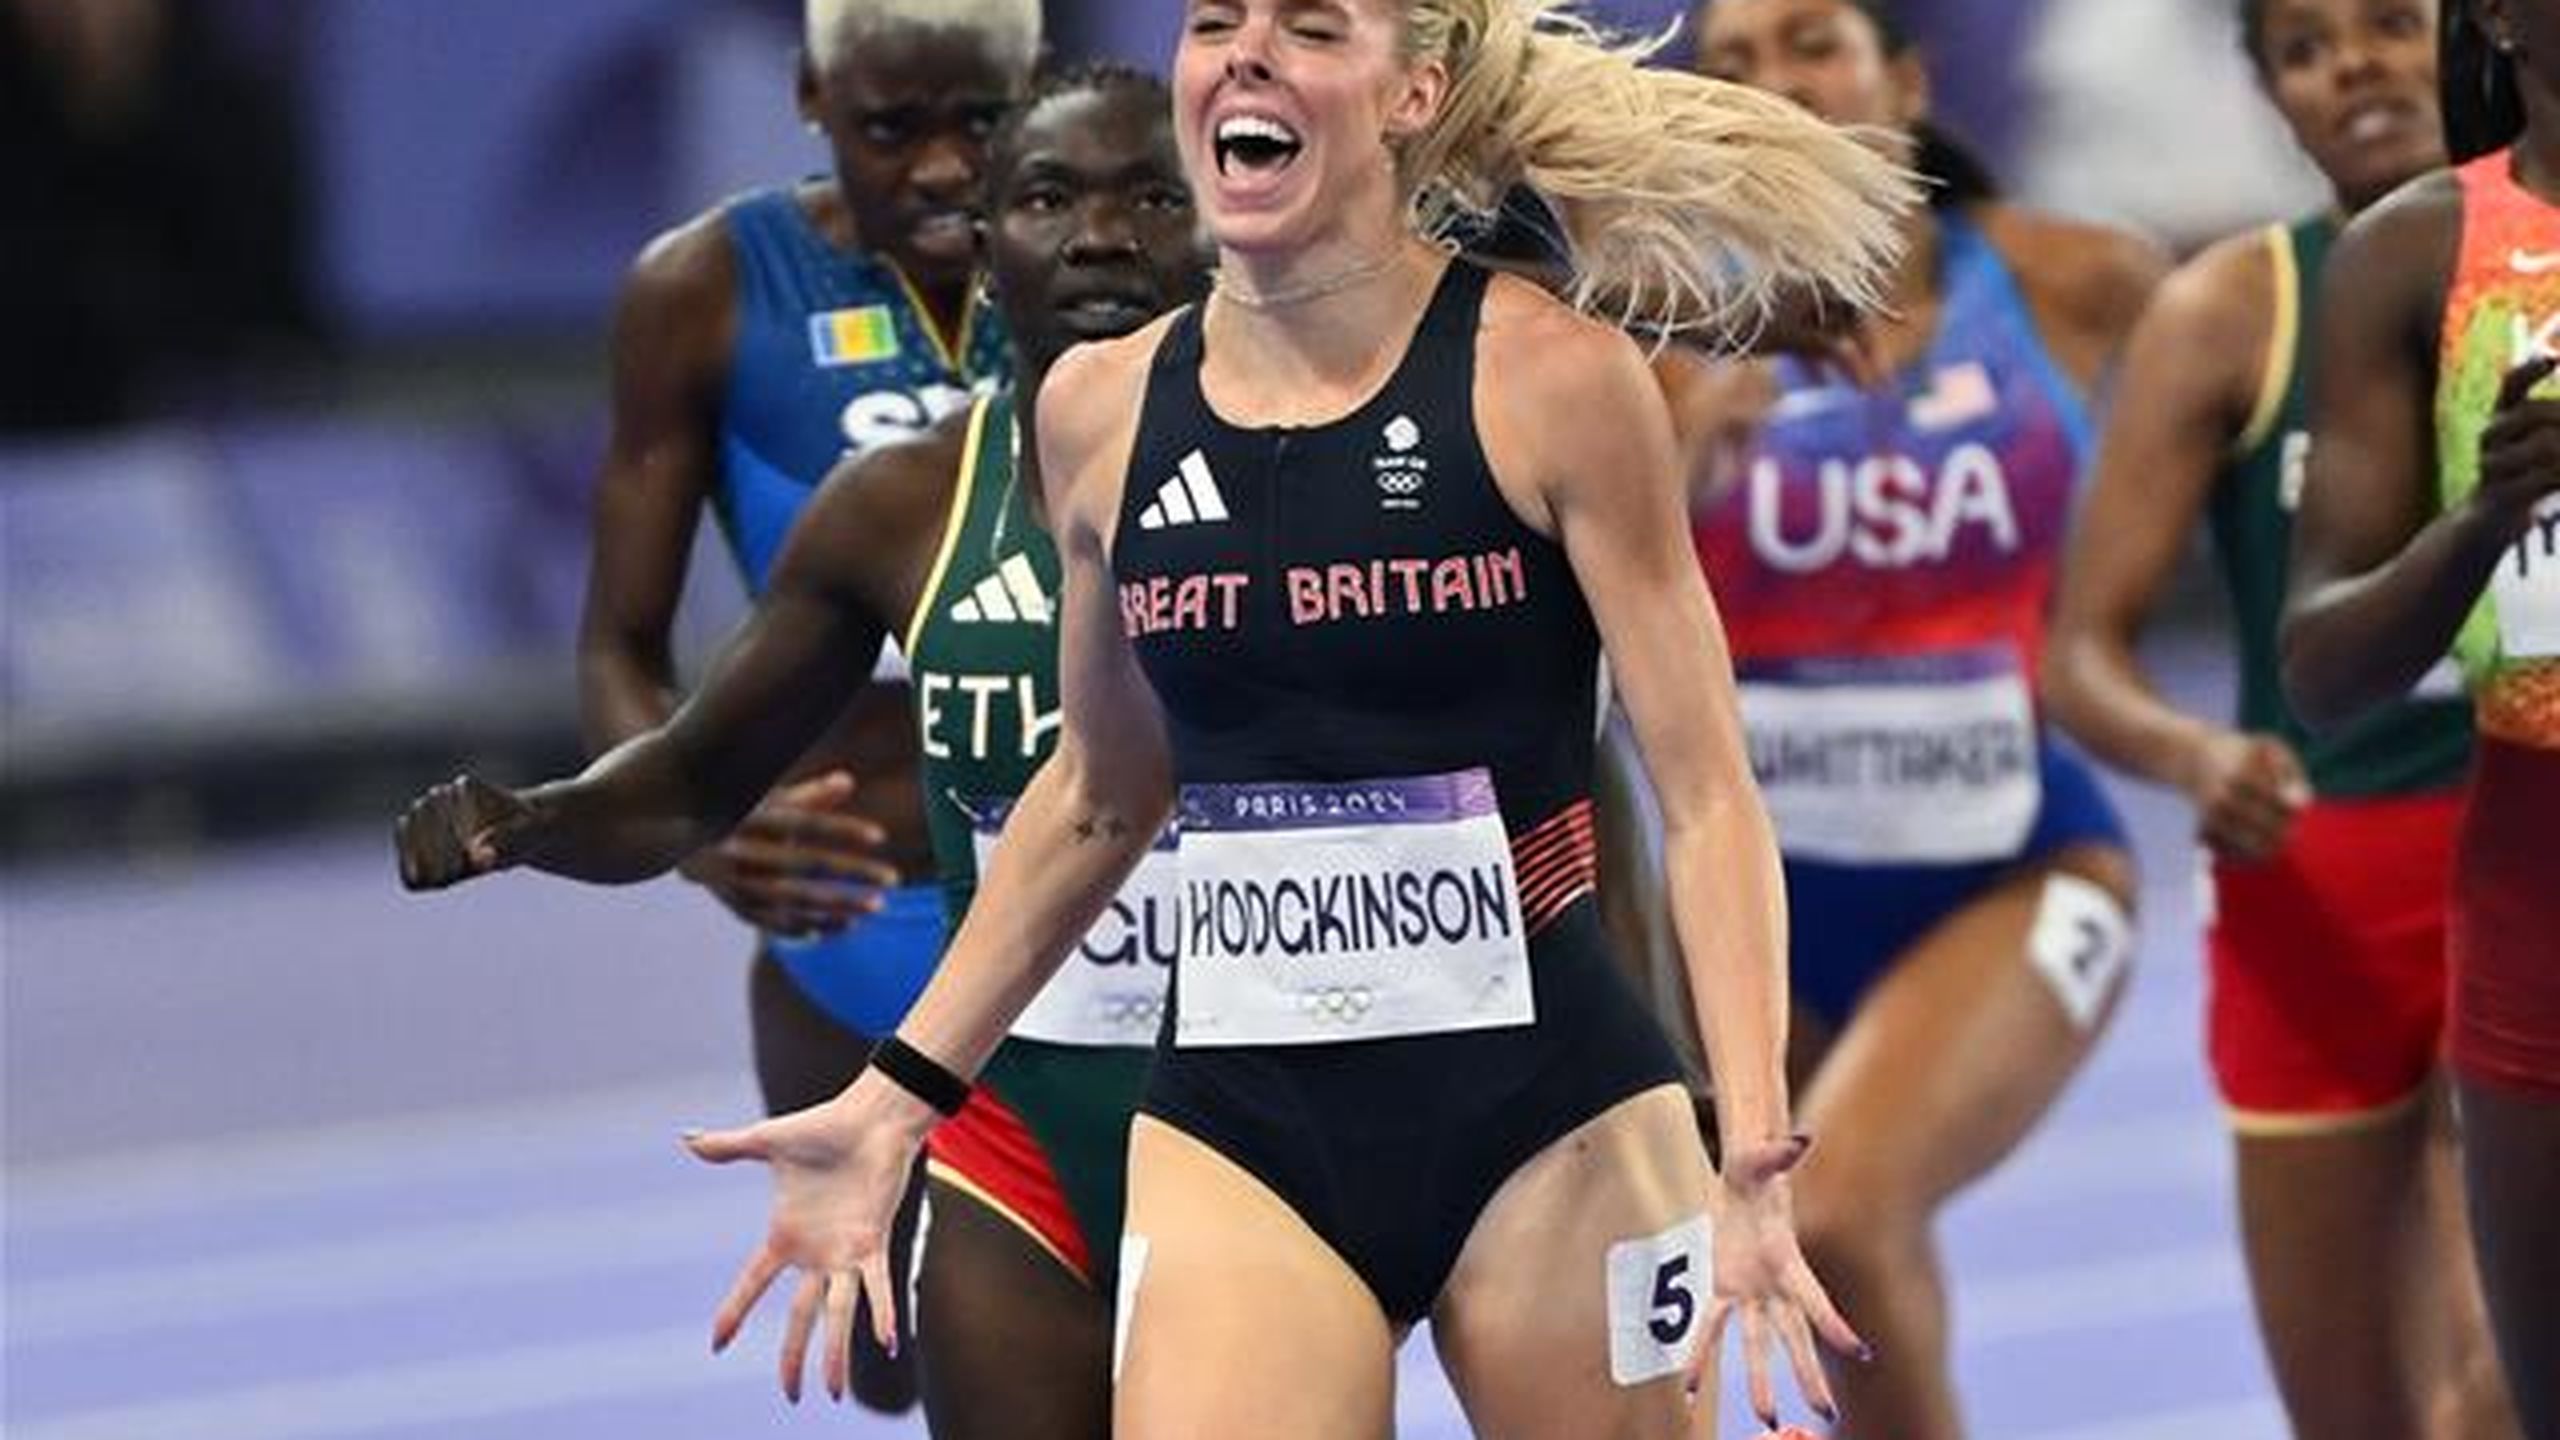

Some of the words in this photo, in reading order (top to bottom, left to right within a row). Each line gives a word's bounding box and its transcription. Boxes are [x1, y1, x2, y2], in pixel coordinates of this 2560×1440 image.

[1748, 441, 2018, 573] USA
[1286, 546, 1527, 626] BRITAIN
[1235, 794, 1318, 817] PARIS
[1326, 790, 1408, 817] 2024
[1188, 862, 1511, 957] HODGKINSON
[2070, 914, 2112, 976] 2
[1646, 1253, 1694, 1345] 5
